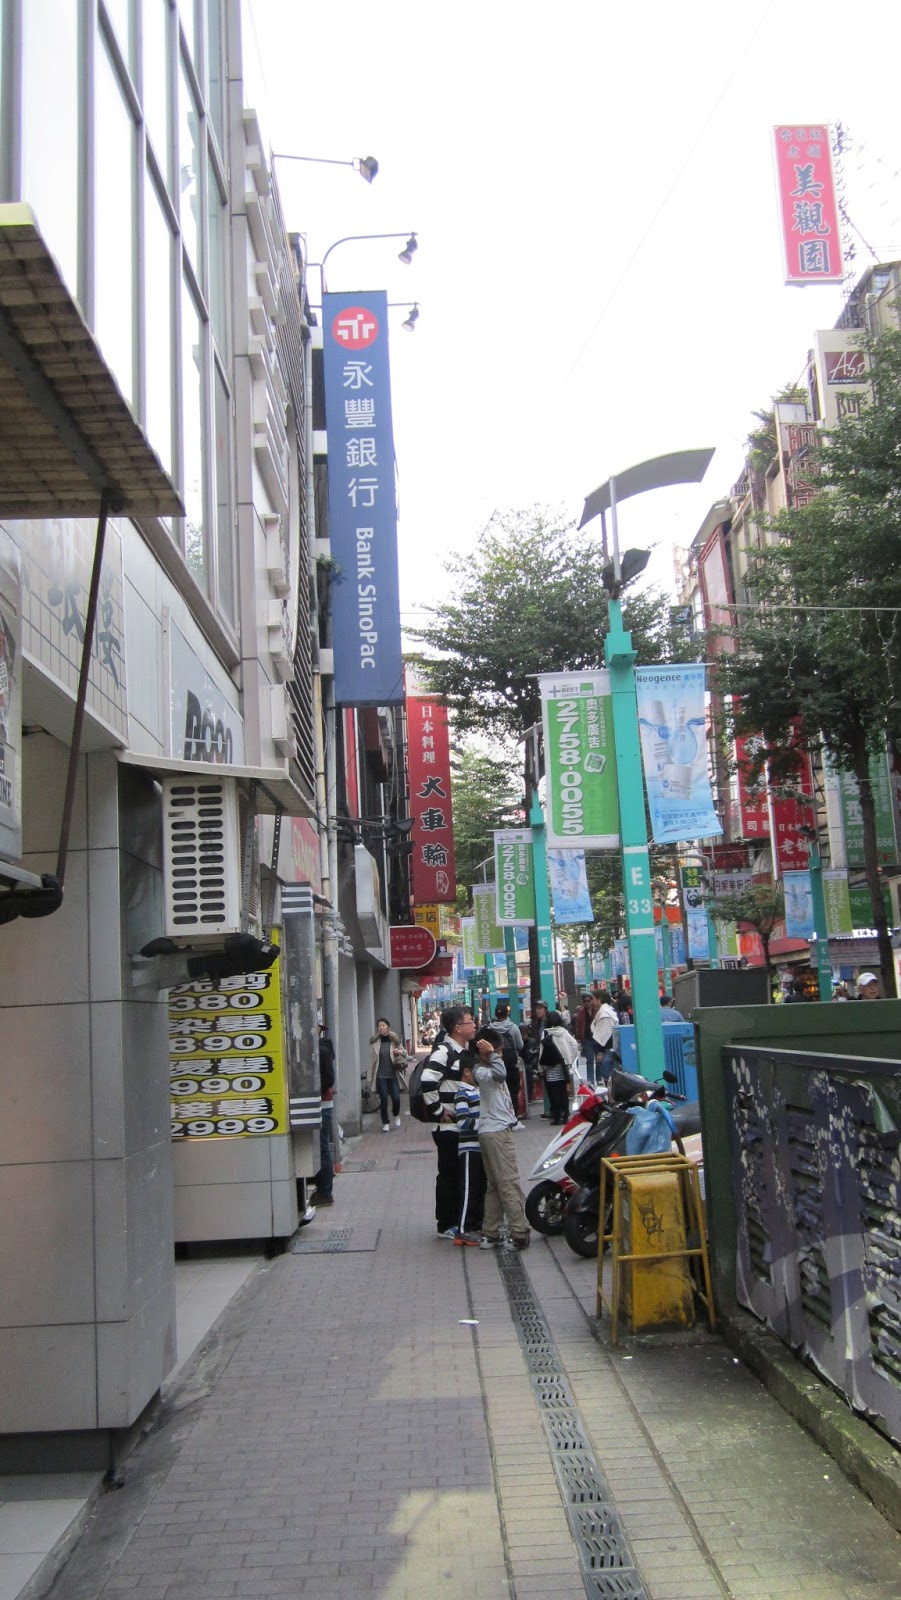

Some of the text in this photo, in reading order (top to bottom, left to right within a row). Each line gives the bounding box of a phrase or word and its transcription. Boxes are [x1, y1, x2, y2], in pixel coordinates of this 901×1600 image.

[790, 163, 831, 274] 美觀園
[342, 360, 379, 508] 永豐銀行
[356, 527, 376, 669] Bank SinoPac
[636, 674, 682, 684] Neogence
[421, 705, 436, 764] 日本料理
[416, 776, 448, 867] 大車輪
[632, 867, 643, 886] E
[629, 898, 651, 915] 33
[169, 992, 262, 1011] 380
[170, 1033, 266, 1054] 890
[170, 1075, 264, 1096] 990
[171, 1117, 276, 1137] 2999
